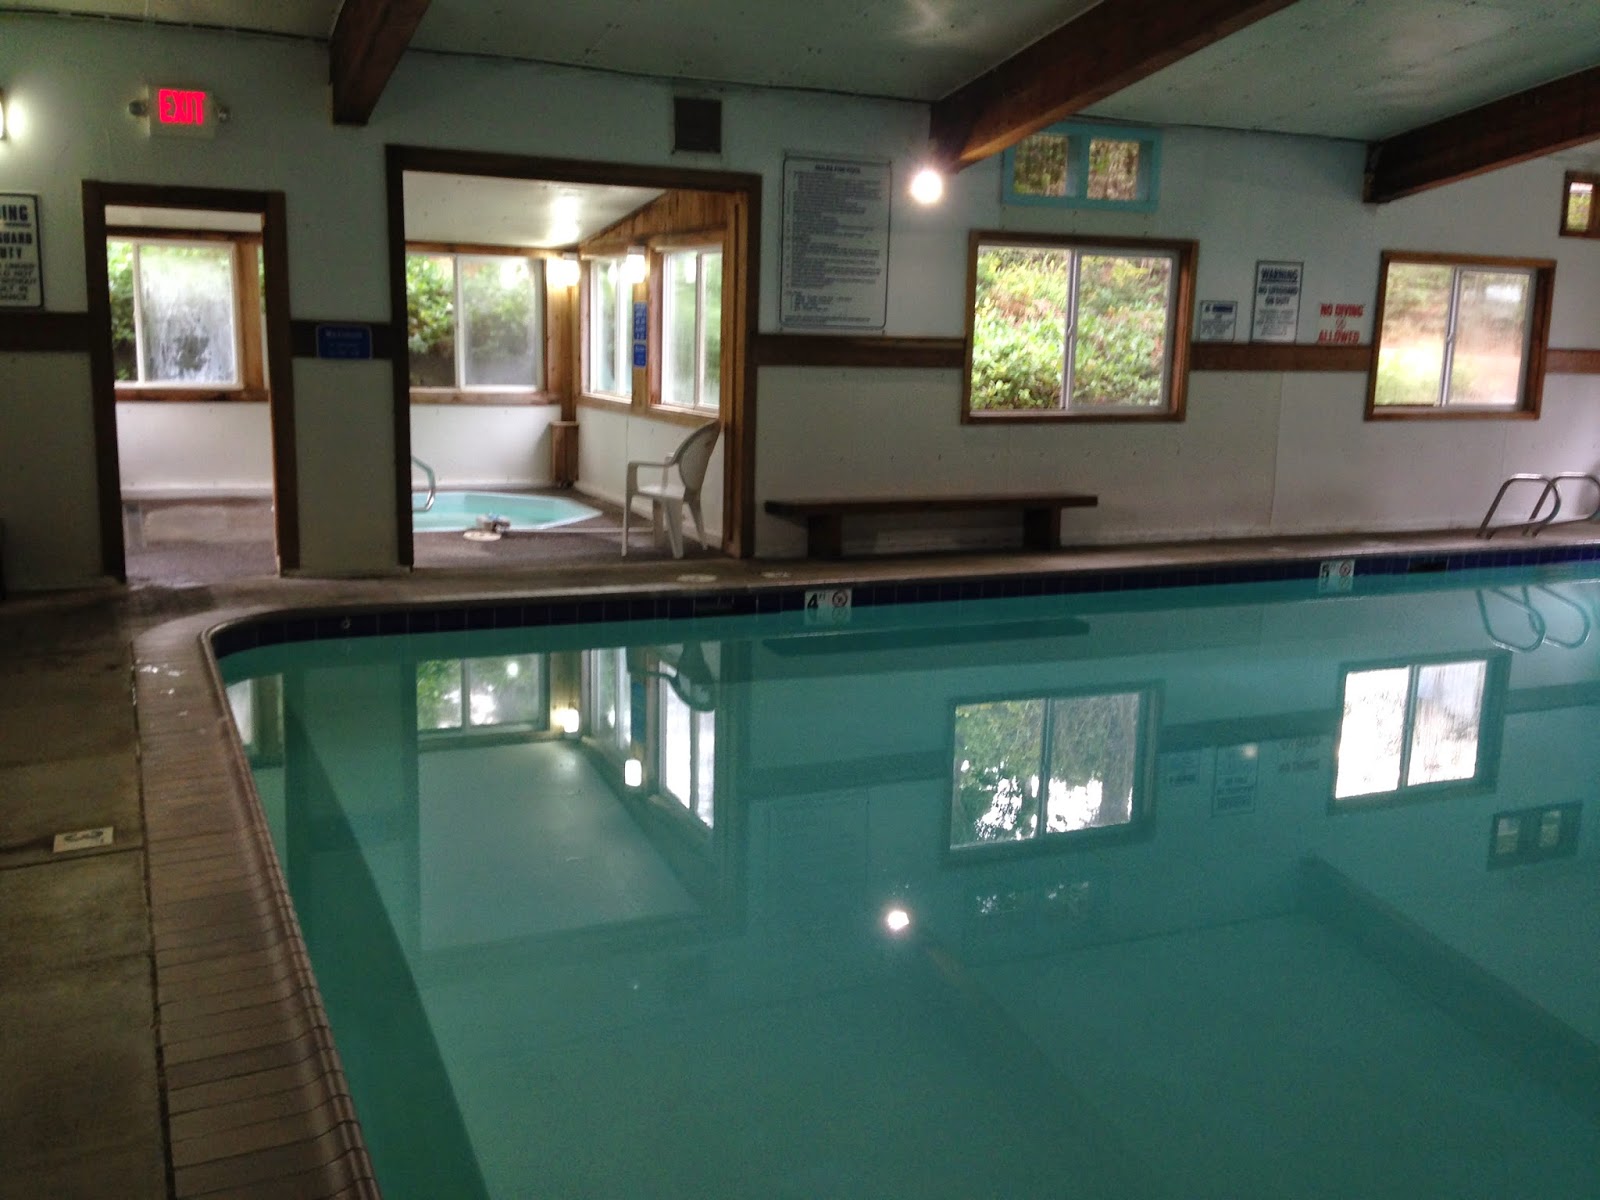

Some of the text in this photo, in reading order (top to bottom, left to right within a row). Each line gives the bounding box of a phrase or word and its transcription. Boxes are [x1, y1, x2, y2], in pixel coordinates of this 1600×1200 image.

[158, 88, 206, 125] EXIT
[1261, 268, 1298, 281] WARNING
[1320, 303, 1364, 317] NO DIVING
[1318, 329, 1360, 344] ALLOWED
